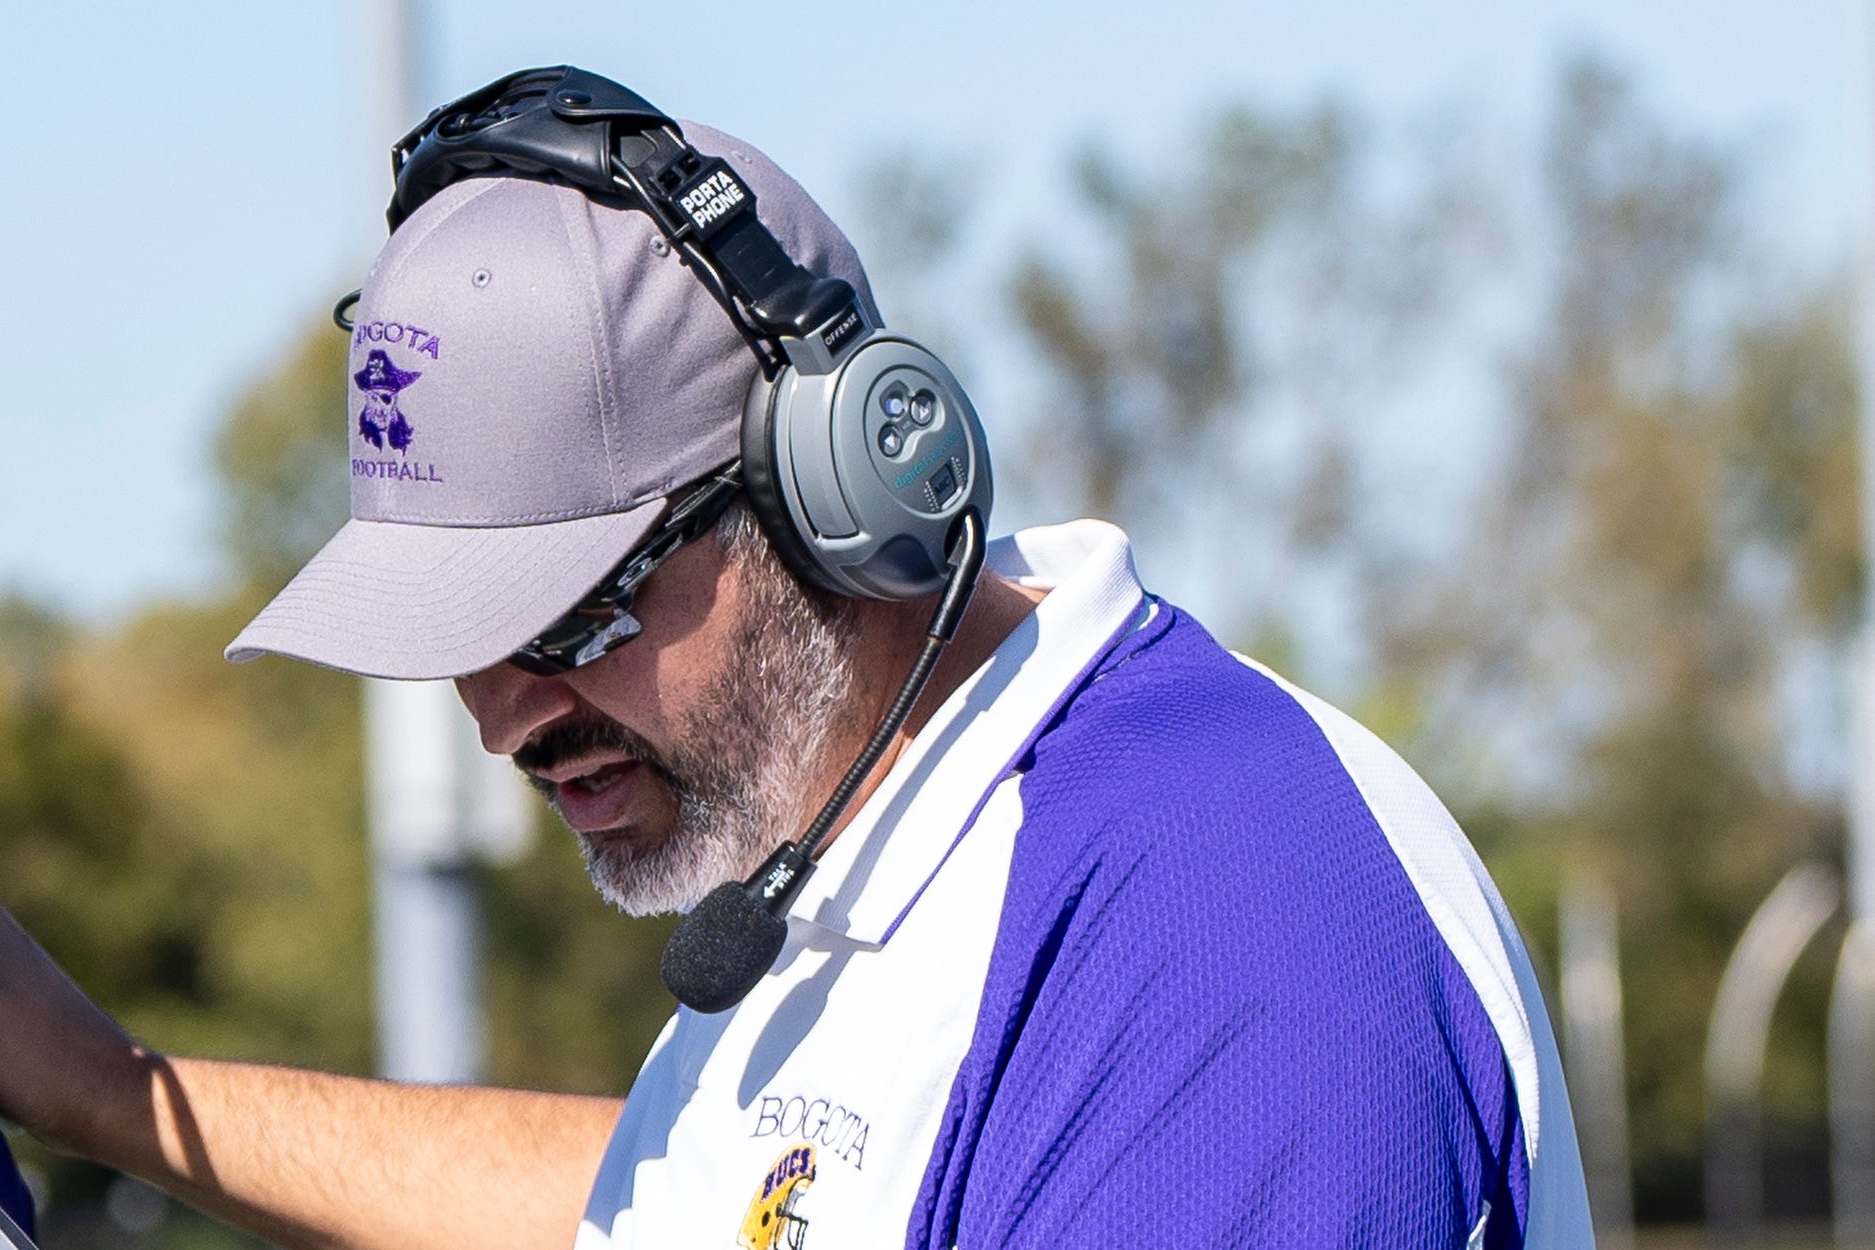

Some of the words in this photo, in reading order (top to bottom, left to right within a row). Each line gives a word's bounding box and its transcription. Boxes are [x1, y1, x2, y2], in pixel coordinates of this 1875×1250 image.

[680, 171, 733, 214] PORTA
[692, 183, 745, 228] PHONE
[354, 321, 440, 360] OGOTA
[825, 312, 858, 345] OFFENSE
[352, 458, 443, 483] FOOTBALL
[748, 1096, 869, 1171] BOGOTA
